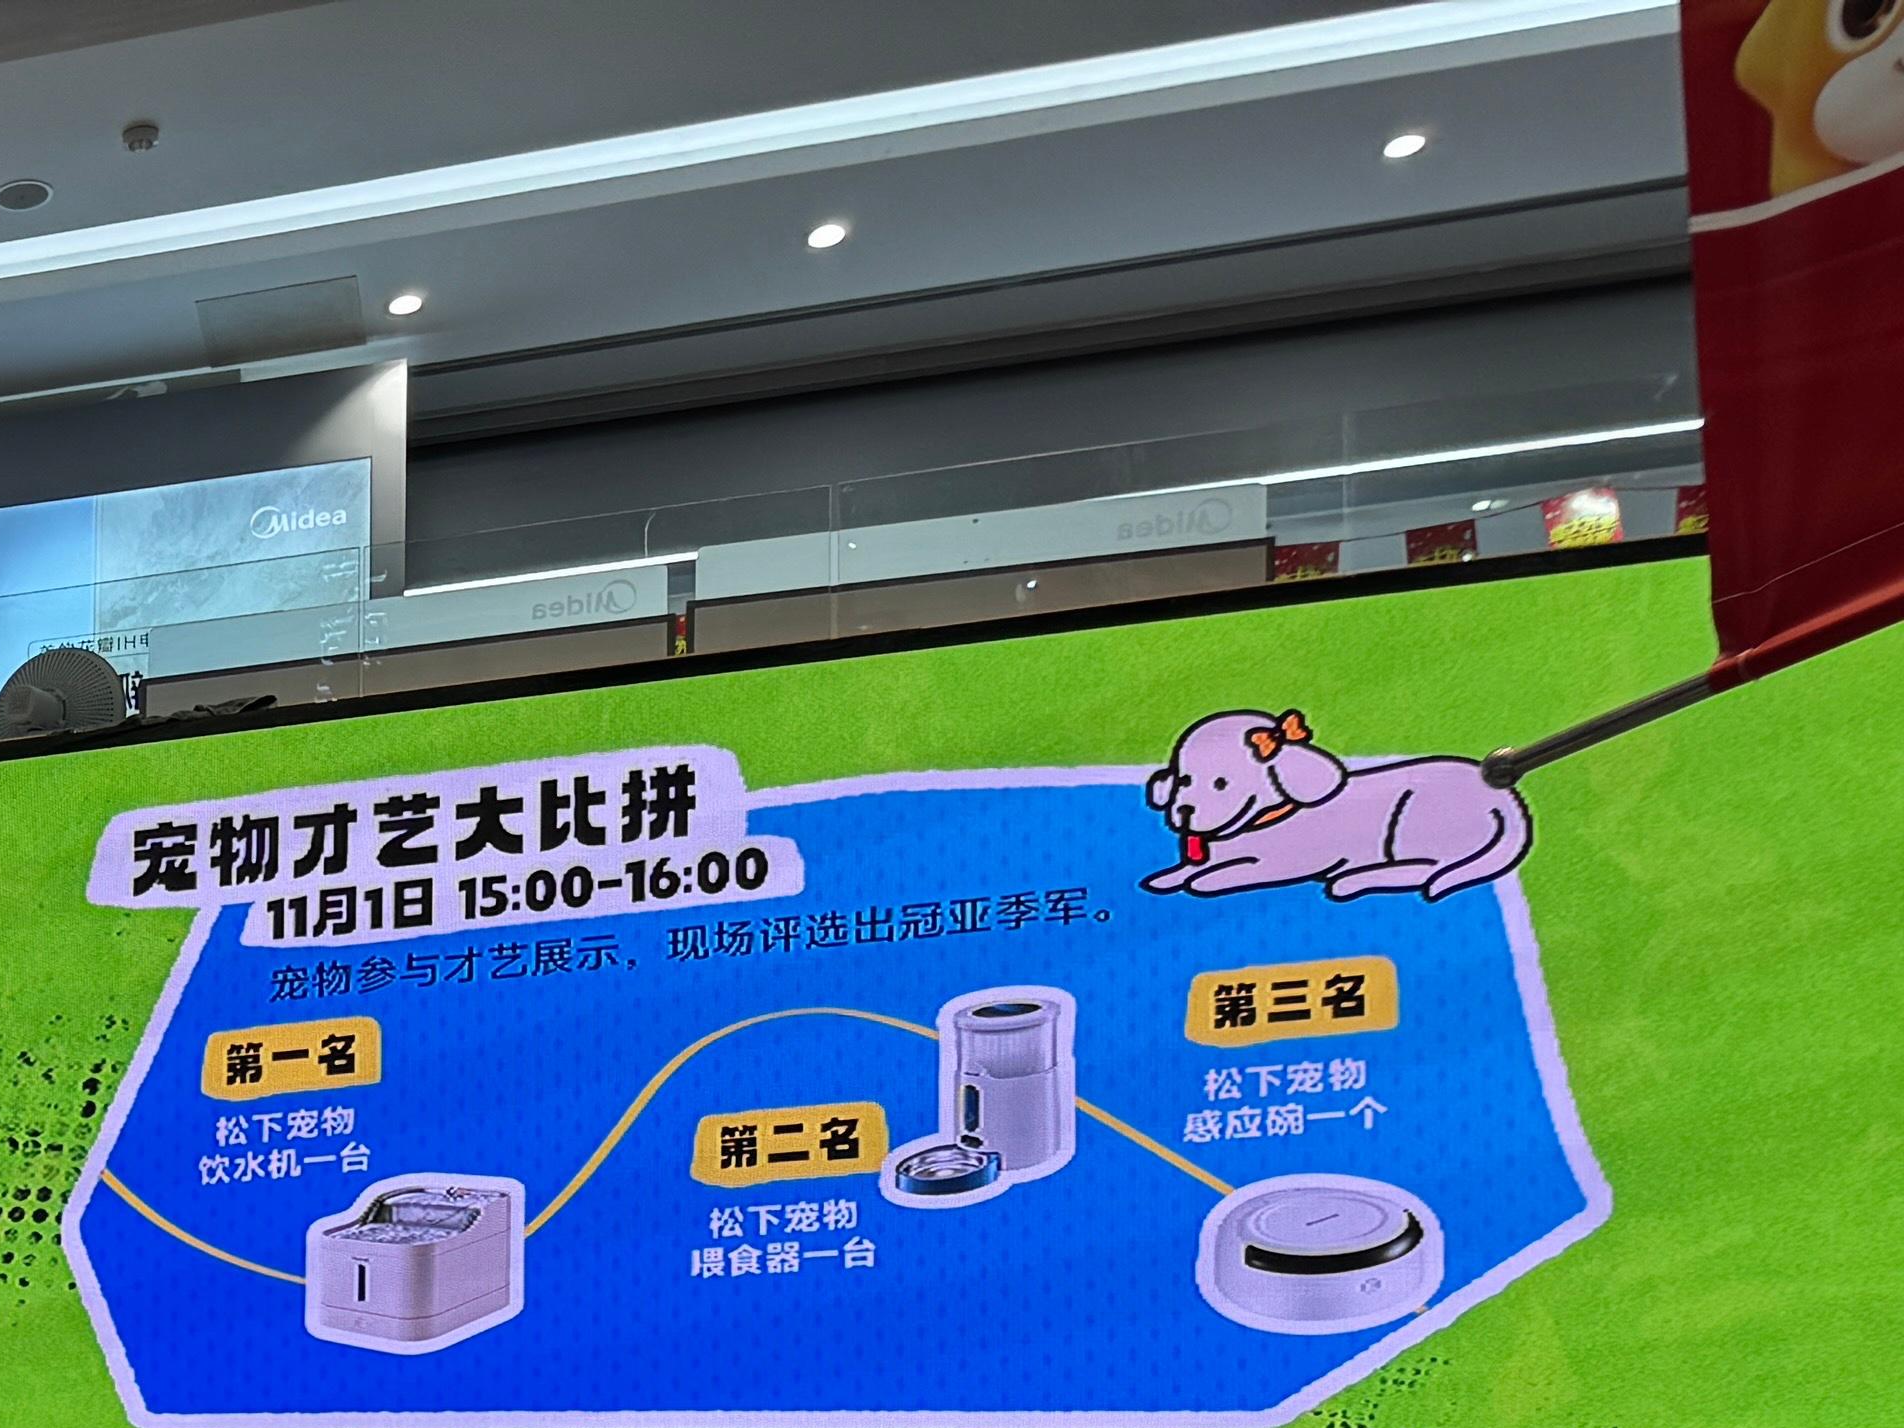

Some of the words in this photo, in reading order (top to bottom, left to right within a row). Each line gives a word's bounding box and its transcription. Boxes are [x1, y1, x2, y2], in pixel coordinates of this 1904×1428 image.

[251, 505, 347, 539] Midea
[132, 763, 697, 894] 宠物才艺大比拼
[265, 876, 437, 938] 11月1日
[458, 846, 770, 917] 15:00-16:00
[1212, 973, 1367, 1030] 第三名
[225, 1032, 358, 1087] 第一名
[1204, 1058, 1368, 1102] 松下宠物
[215, 1105, 357, 1148] 松下宠物
[719, 1115, 861, 1171] 第二名
[1183, 1096, 1388, 1143] 感应碗一个
[198, 1141, 372, 1187] 饮水机一台
[709, 1199, 859, 1238] 松下宠物
